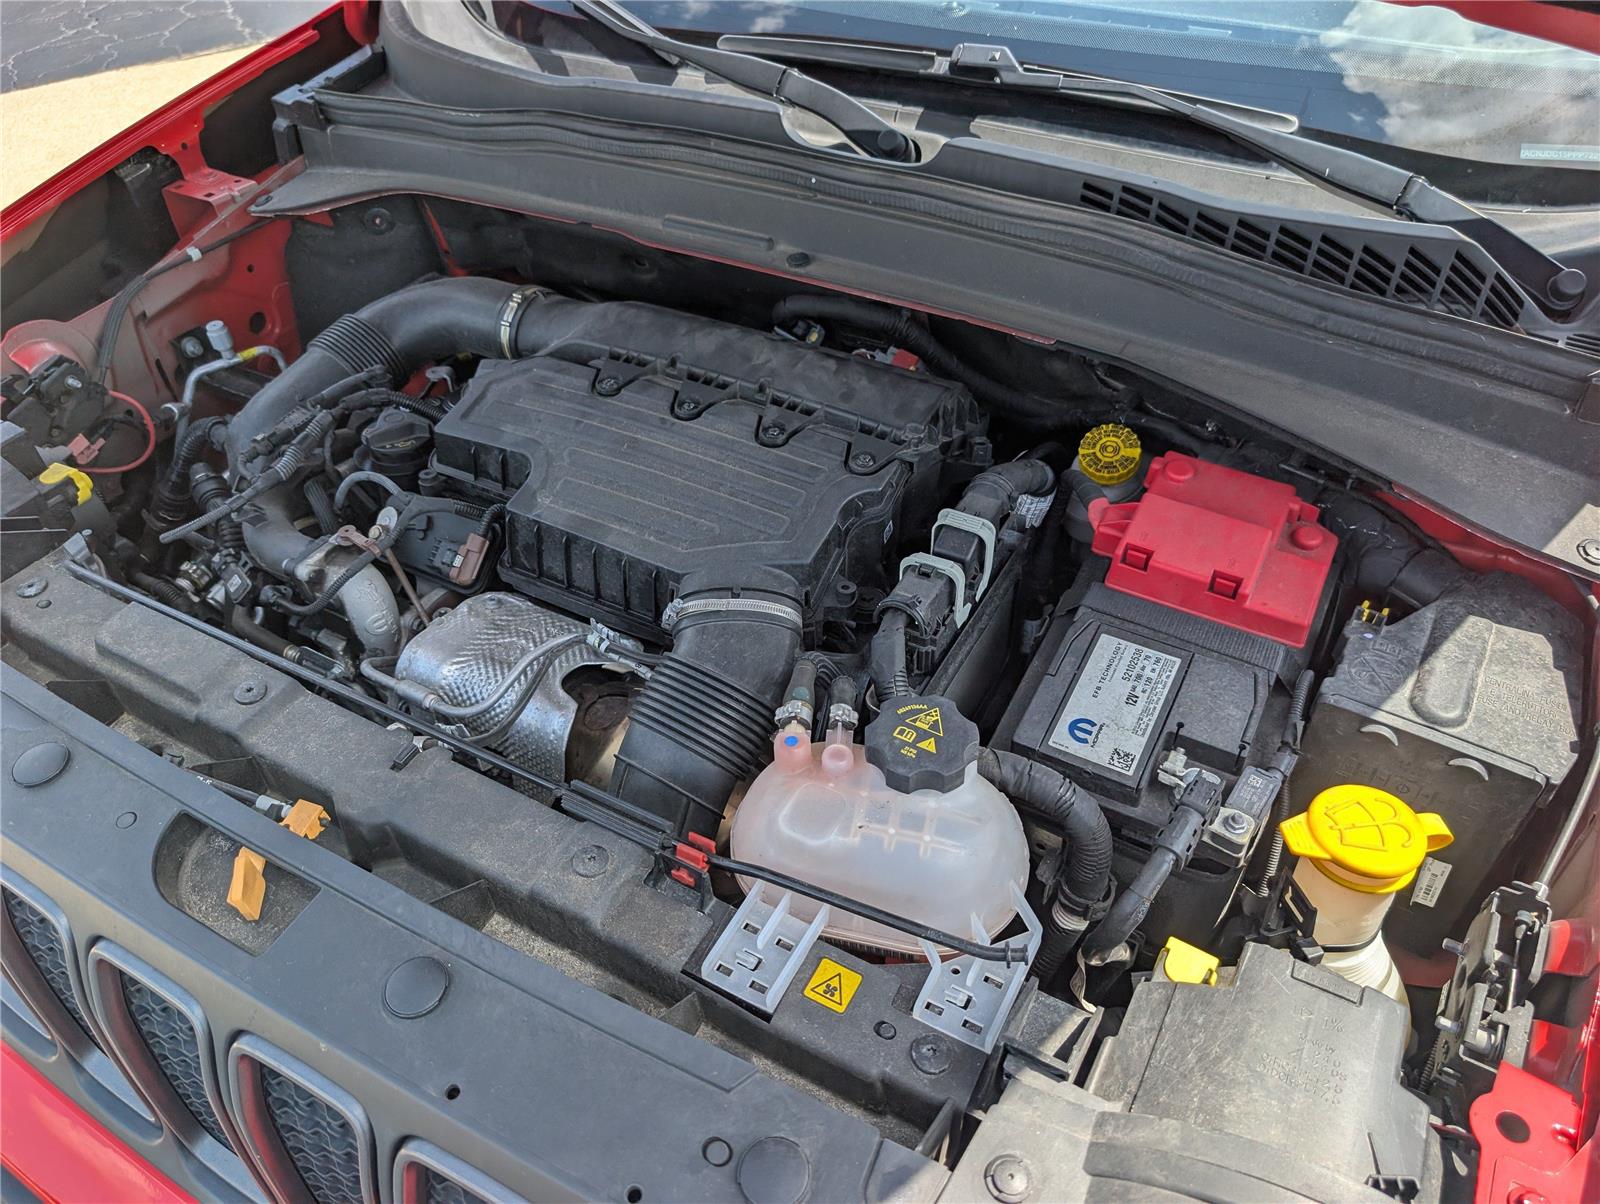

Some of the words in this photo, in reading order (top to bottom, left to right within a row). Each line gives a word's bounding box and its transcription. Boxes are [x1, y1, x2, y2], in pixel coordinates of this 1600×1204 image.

[1092, 686, 1102, 699] EFB
[1099, 642, 1123, 684] TECHNOLOGY
[1122, 648, 1144, 682] 52102538
[1144, 676, 1153, 687] 120
[1484, 675, 1535, 700] CENTRALINA
[1125, 692, 1140, 707] 12V
[1477, 694, 1499, 708] FUSE
[1503, 705, 1522, 716] AND
[1524, 713, 1554, 729] RELAY
[1091, 724, 1104, 748] MOPAR
